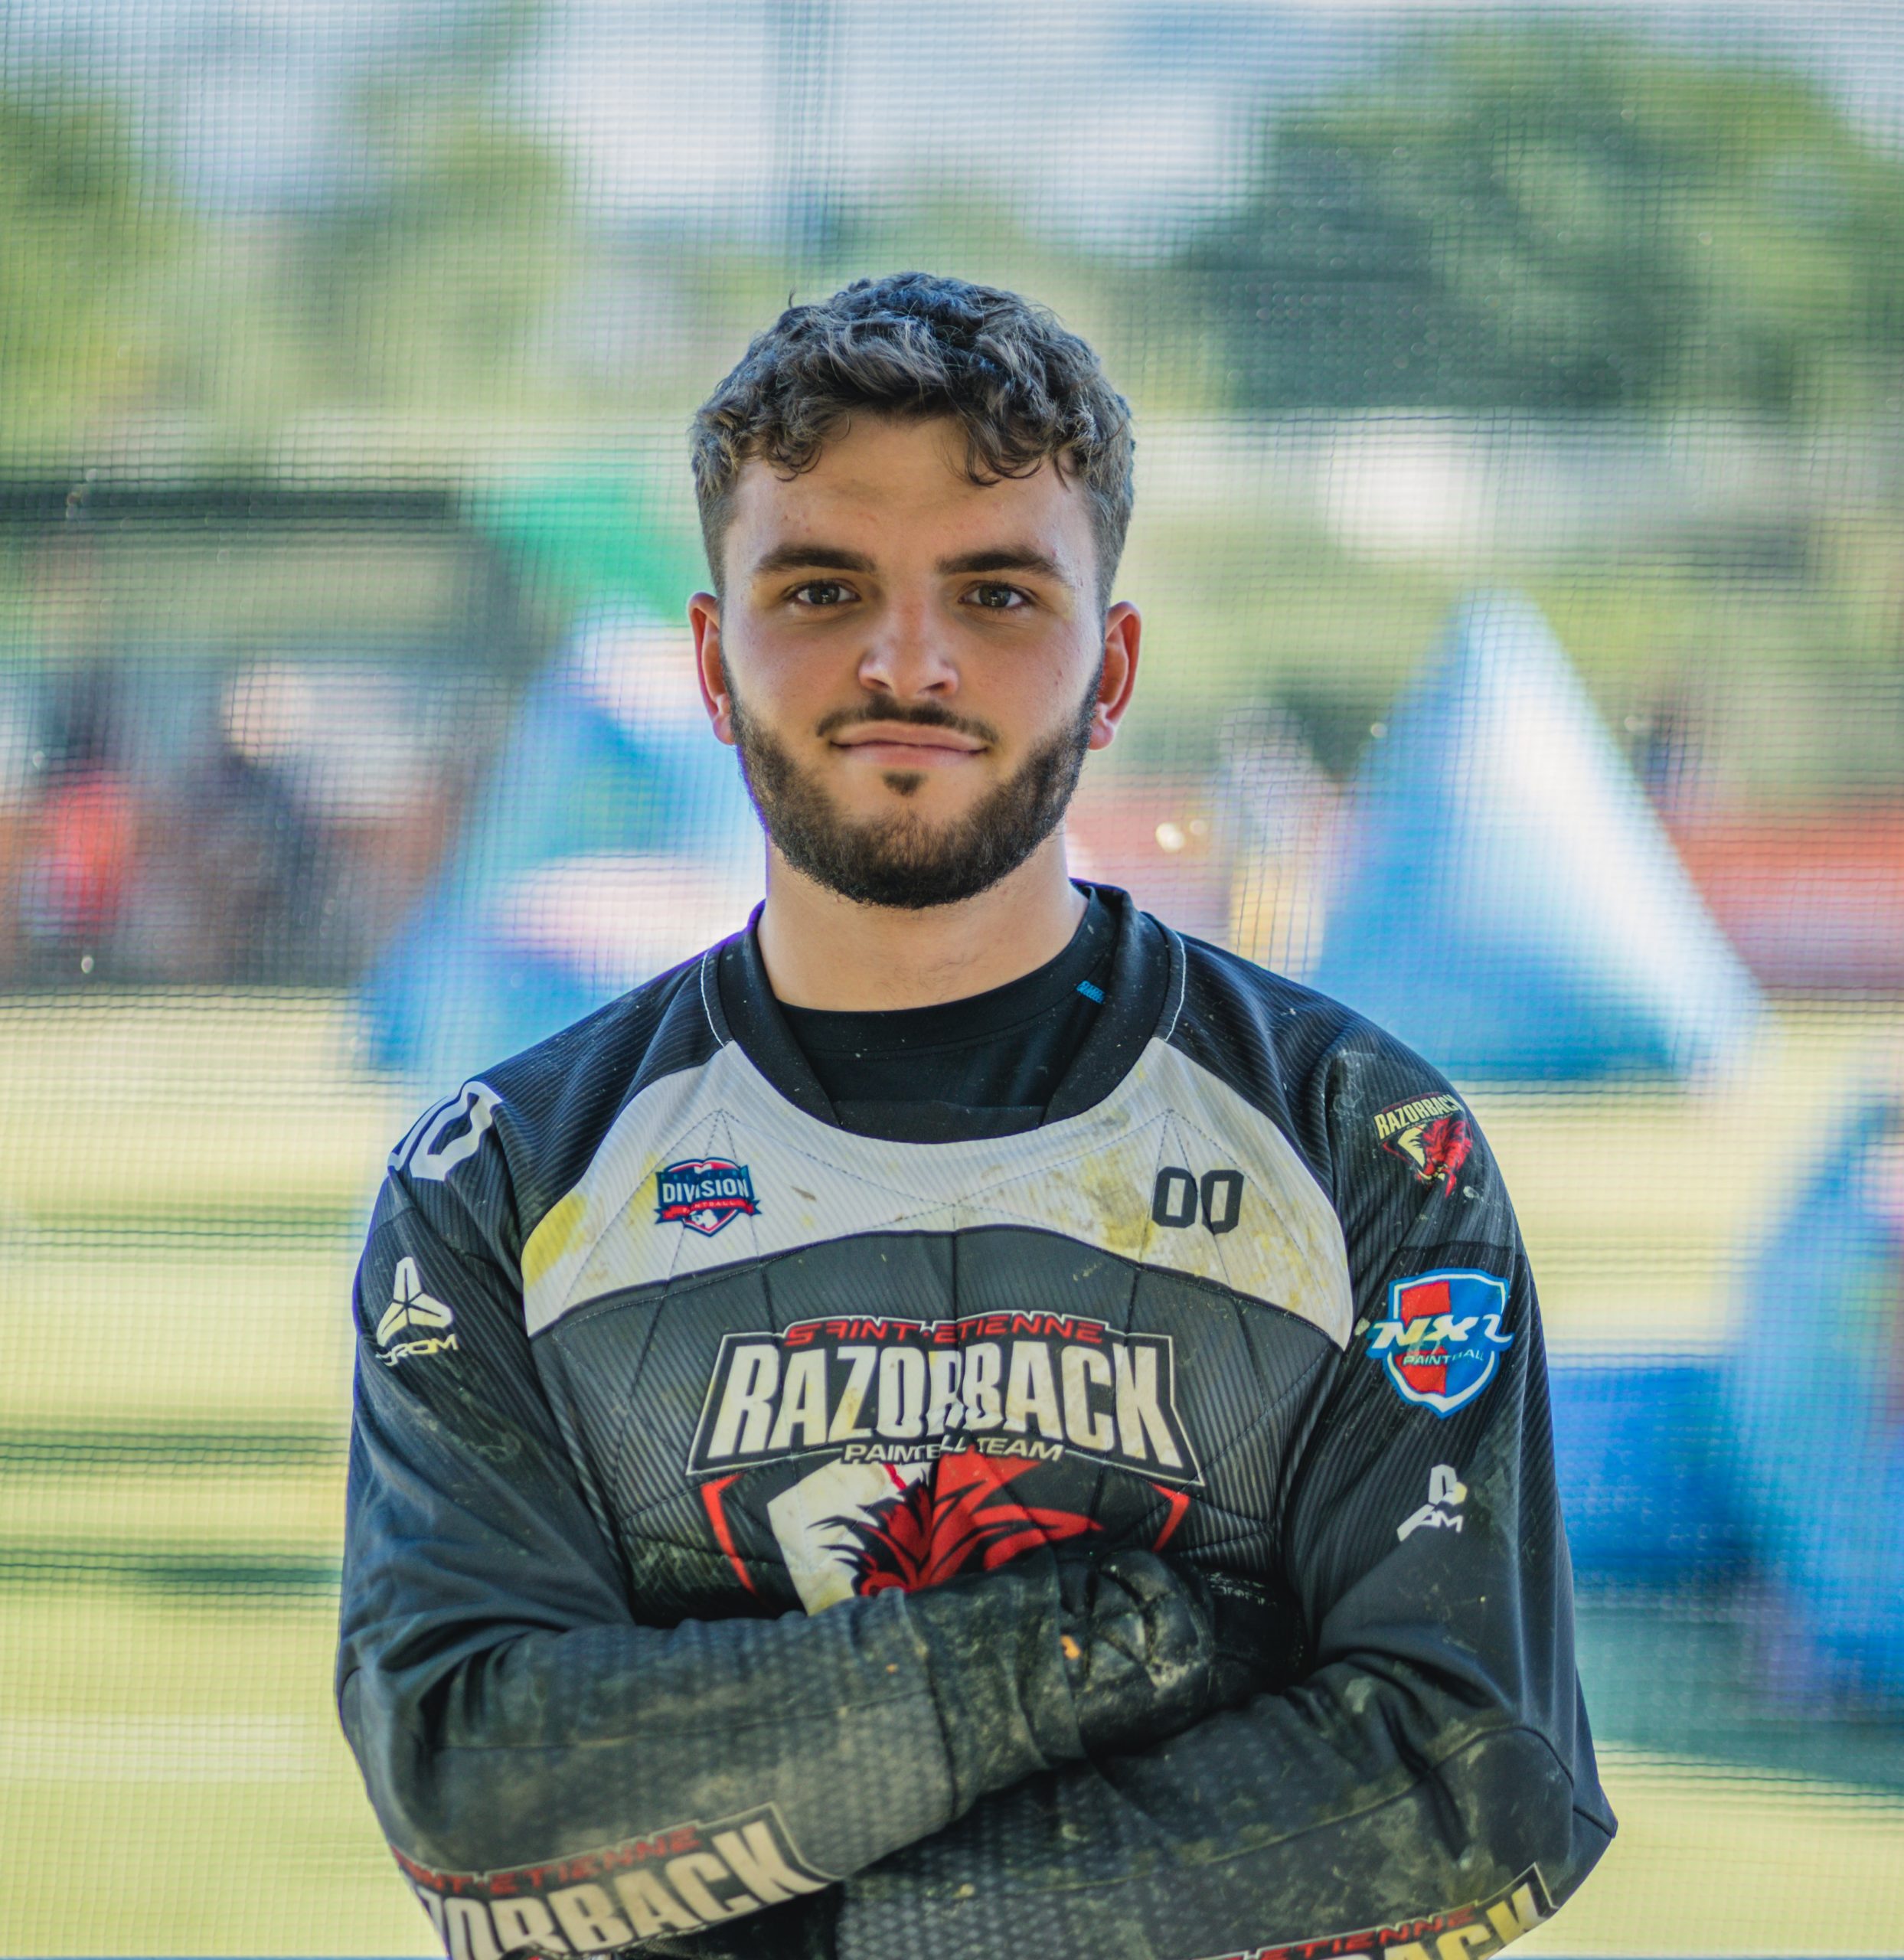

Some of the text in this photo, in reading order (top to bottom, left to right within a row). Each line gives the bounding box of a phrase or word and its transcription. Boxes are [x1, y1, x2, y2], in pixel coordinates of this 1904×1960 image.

[662, 1178, 749, 1203] DIVISION
[1152, 1166, 1244, 1235] 00
[707, 1341, 1184, 1468] RAZORBACK
[977, 1437, 1063, 1462] TEAM
